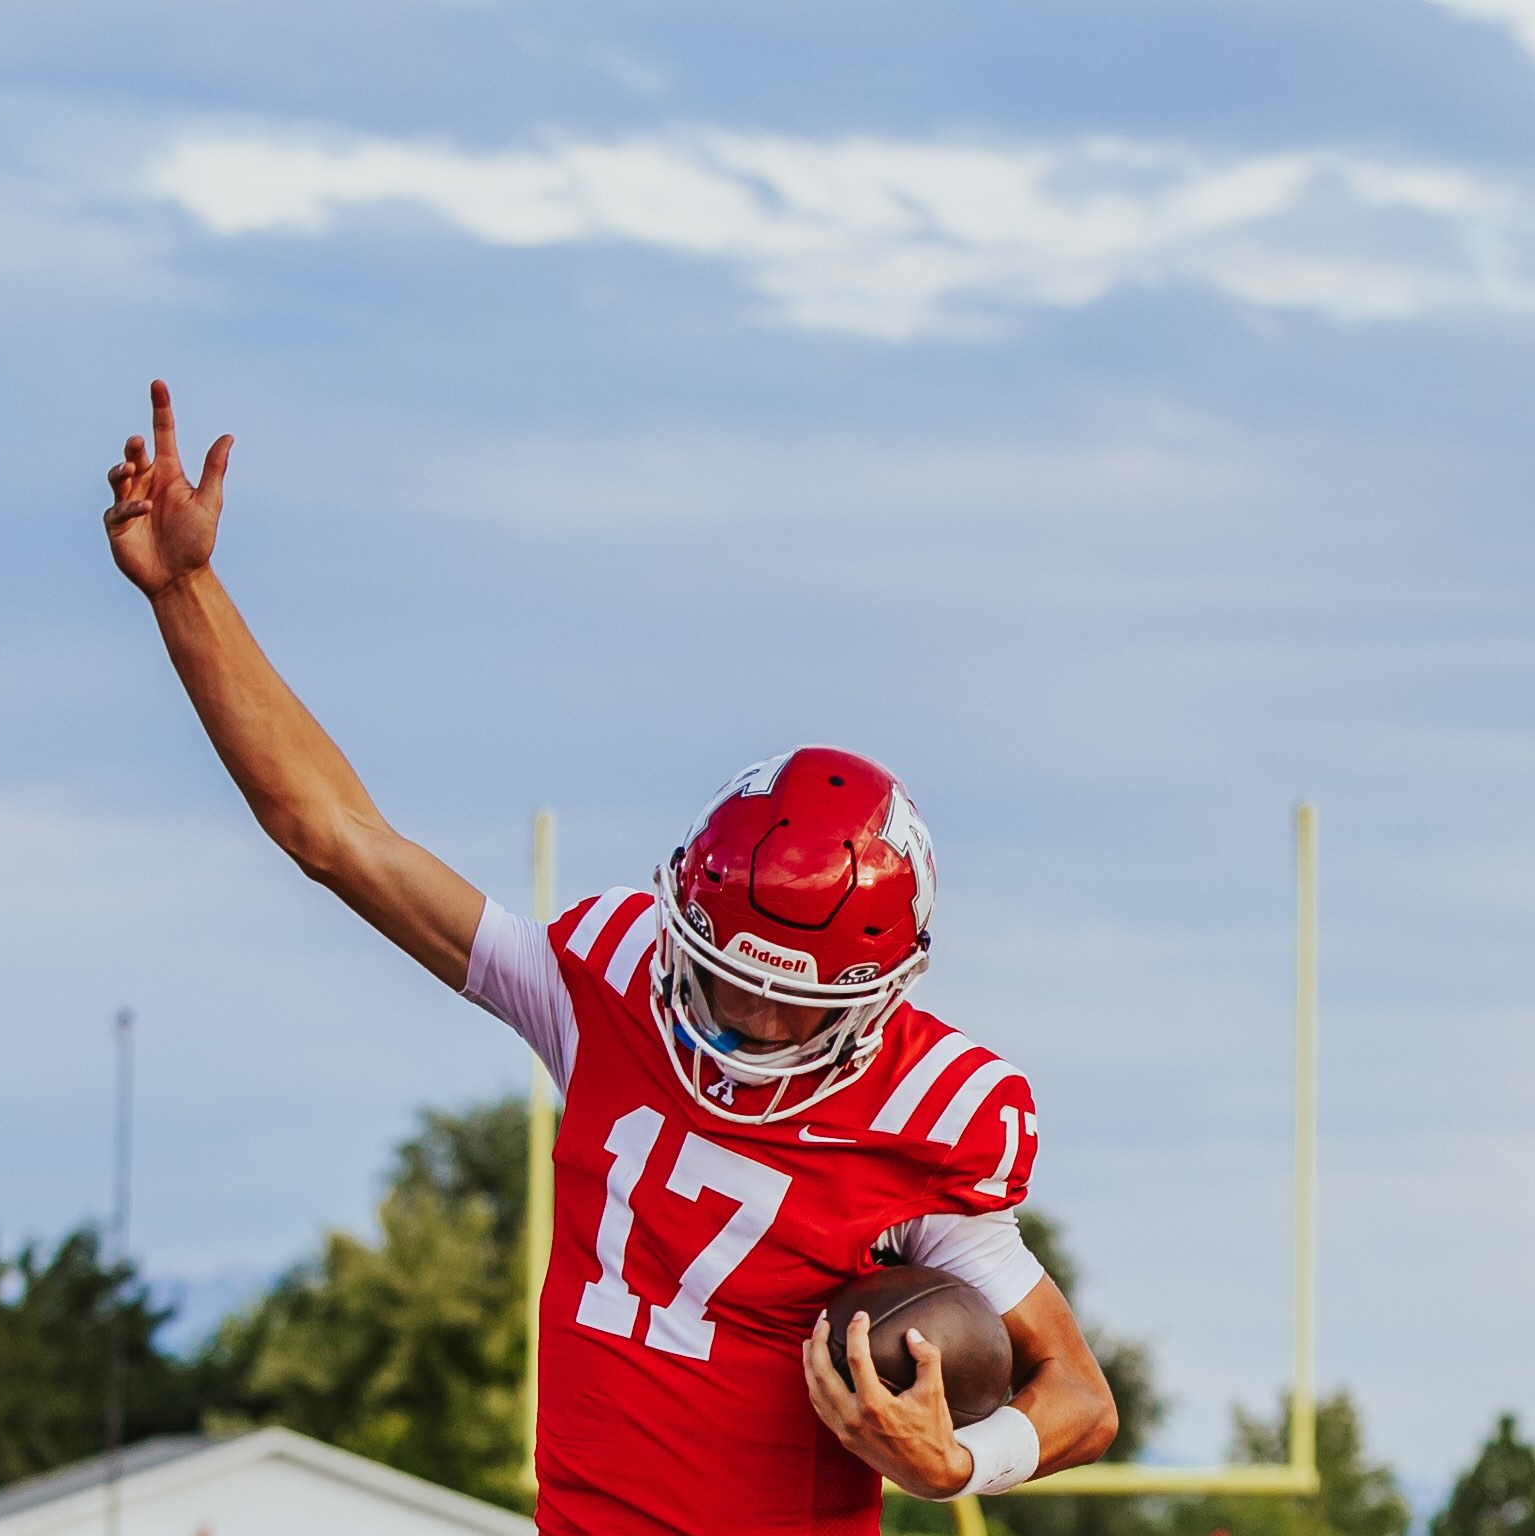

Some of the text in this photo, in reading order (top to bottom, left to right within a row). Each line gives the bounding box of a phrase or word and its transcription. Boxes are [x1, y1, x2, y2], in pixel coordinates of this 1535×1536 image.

[738, 940, 807, 974] Riddell
[706, 1075, 738, 1106] A
[575, 1104, 793, 1361] 17
